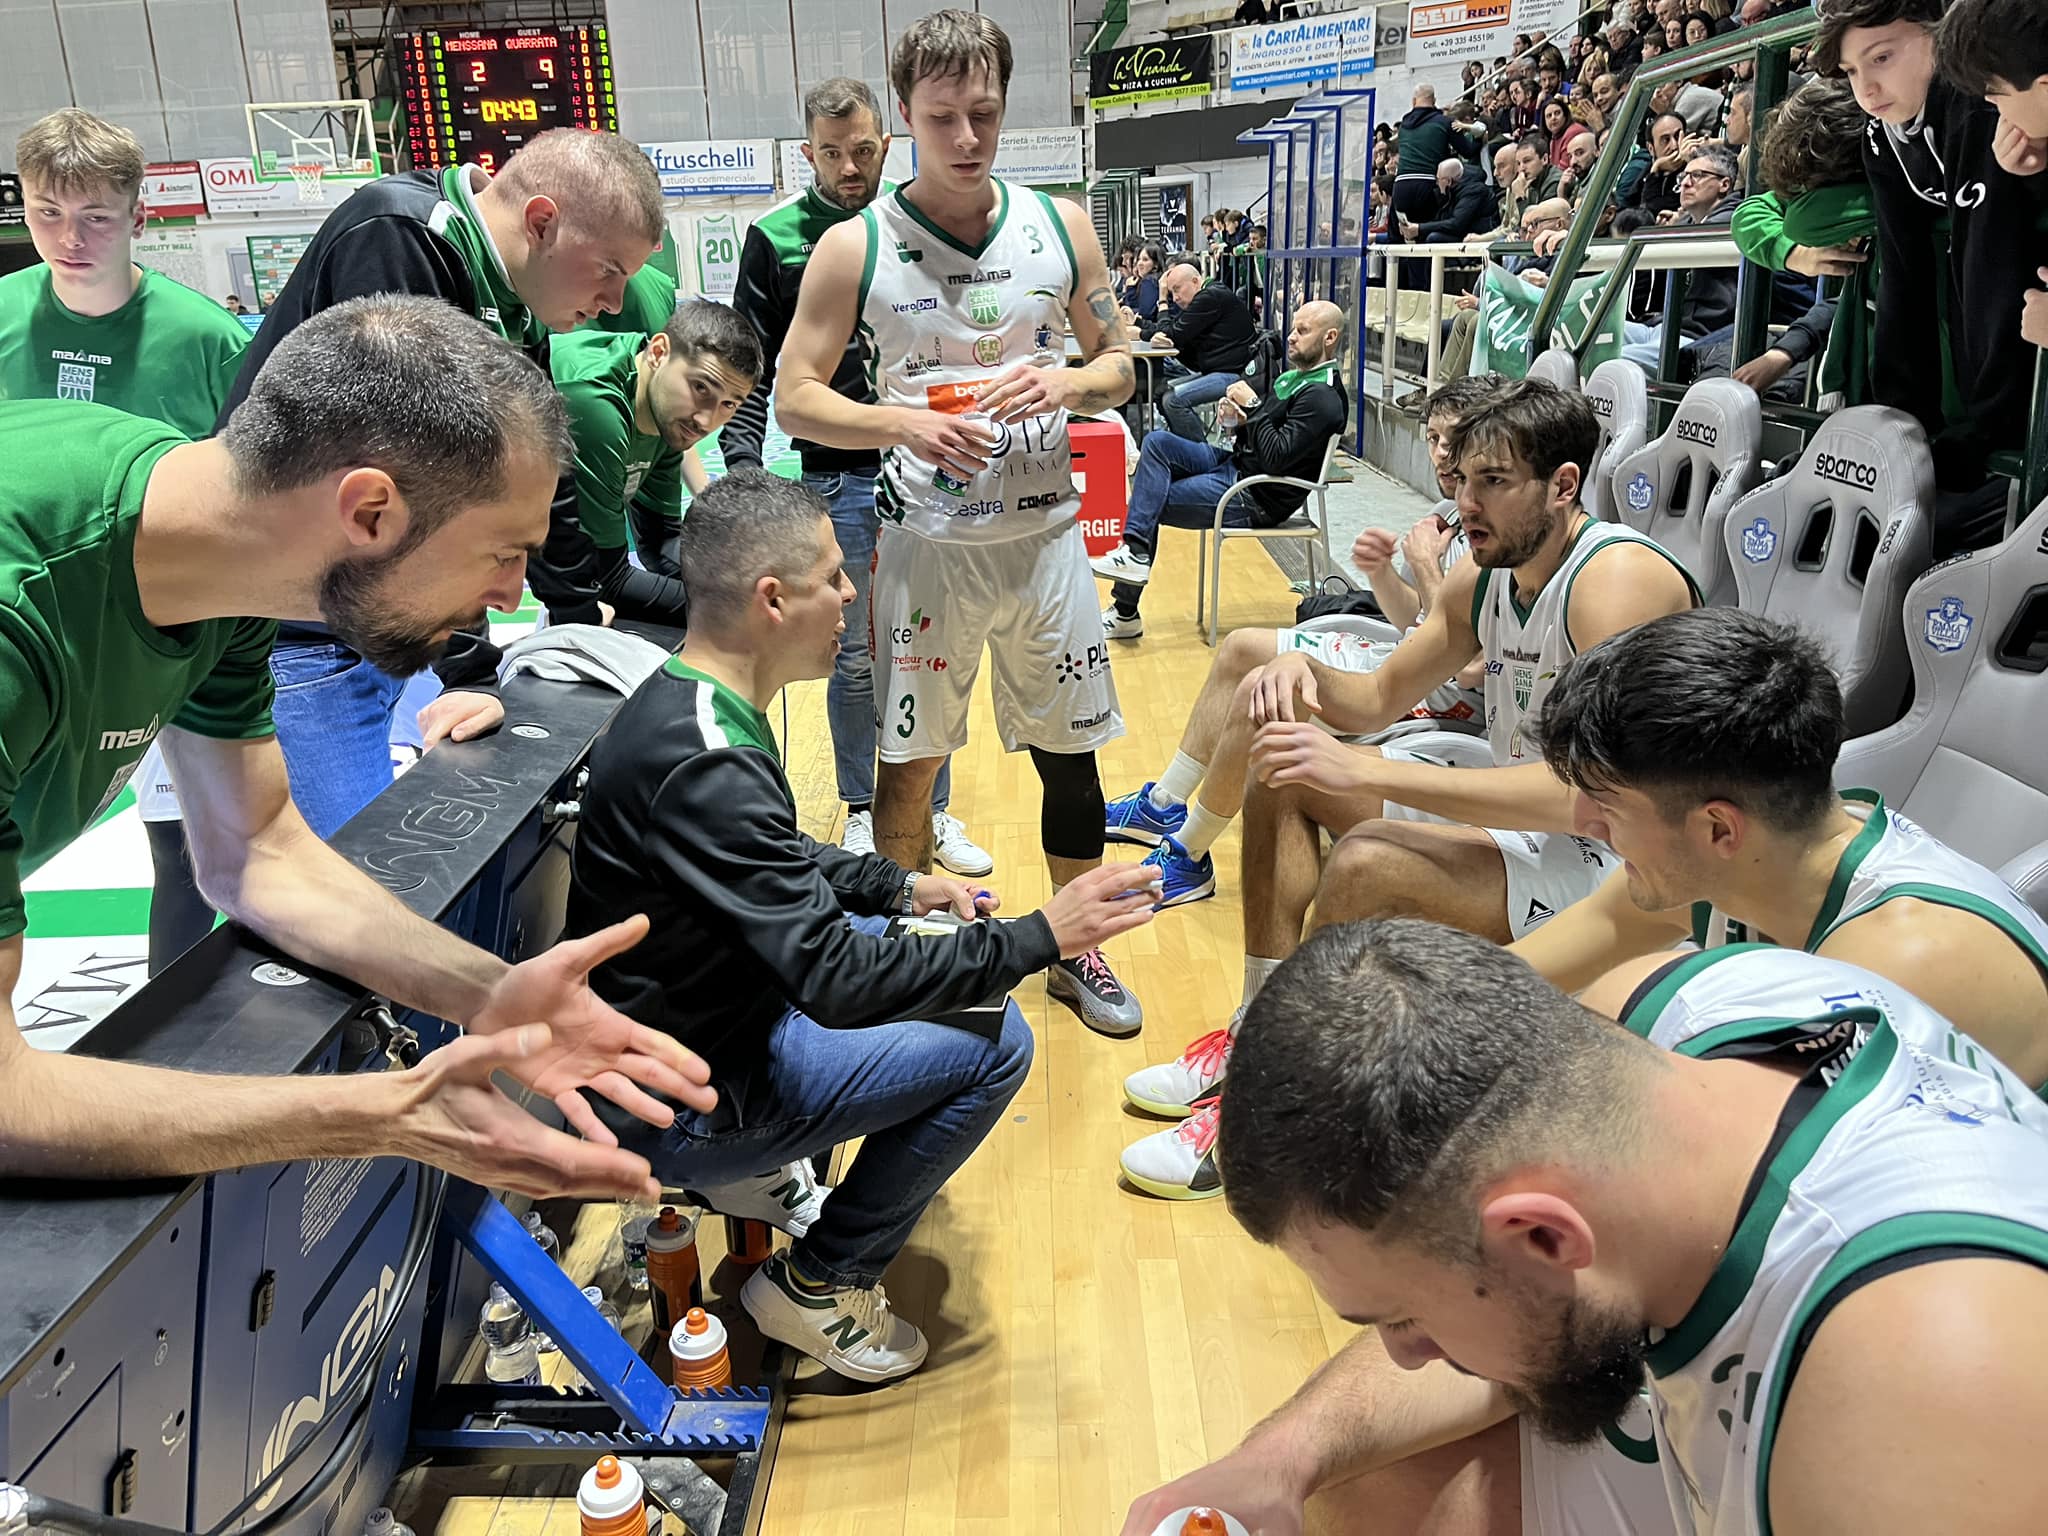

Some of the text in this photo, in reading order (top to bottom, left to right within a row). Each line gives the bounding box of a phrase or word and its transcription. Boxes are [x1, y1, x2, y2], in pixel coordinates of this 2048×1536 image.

[1467, 5, 1507, 19] RENT
[445, 39, 498, 52] MENSSANA
[505, 37, 558, 49] QUARRATA
[1251, 46, 1302, 59] INGROSSO
[1315, 34, 1370, 50] DETTGLIO
[1423, 40, 1438, 49] Cell.
[1440, 39, 1453, 48] +39
[1455, 36, 1467, 45] 335
[1430, 45, 1486, 58] www.bettirent.it
[471, 61, 486, 82] 2
[538, 58, 554, 79] 9
[1125, 46, 1187, 78] Veranda
[1122, 81, 1142, 90] PIZZA
[1151, 77, 1178, 86] CUCINA
[481, 99, 538, 122] 04:43
[1000, 135, 1076, 146] Serietà Efficienza
[480, 153, 496, 174] 2
[654, 146, 754, 171] fruschelli
[666, 174, 756, 185] studio commerciale
[1023, 224, 1044, 254] 3
[705, 239, 734, 264] 20
[968, 287, 996, 297] MENS
[969, 296, 998, 305] SANA
[60, 374, 92, 386] SANA
[61, 365, 93, 378] MENS
[1677, 419, 1718, 444] sparco
[992, 460, 1058, 480] SIENA
[1815, 452, 1878, 487] sparco
[896, 694, 916, 738] 3
[768, 1178, 813, 1211] N
[822, 1315, 871, 1352] N
